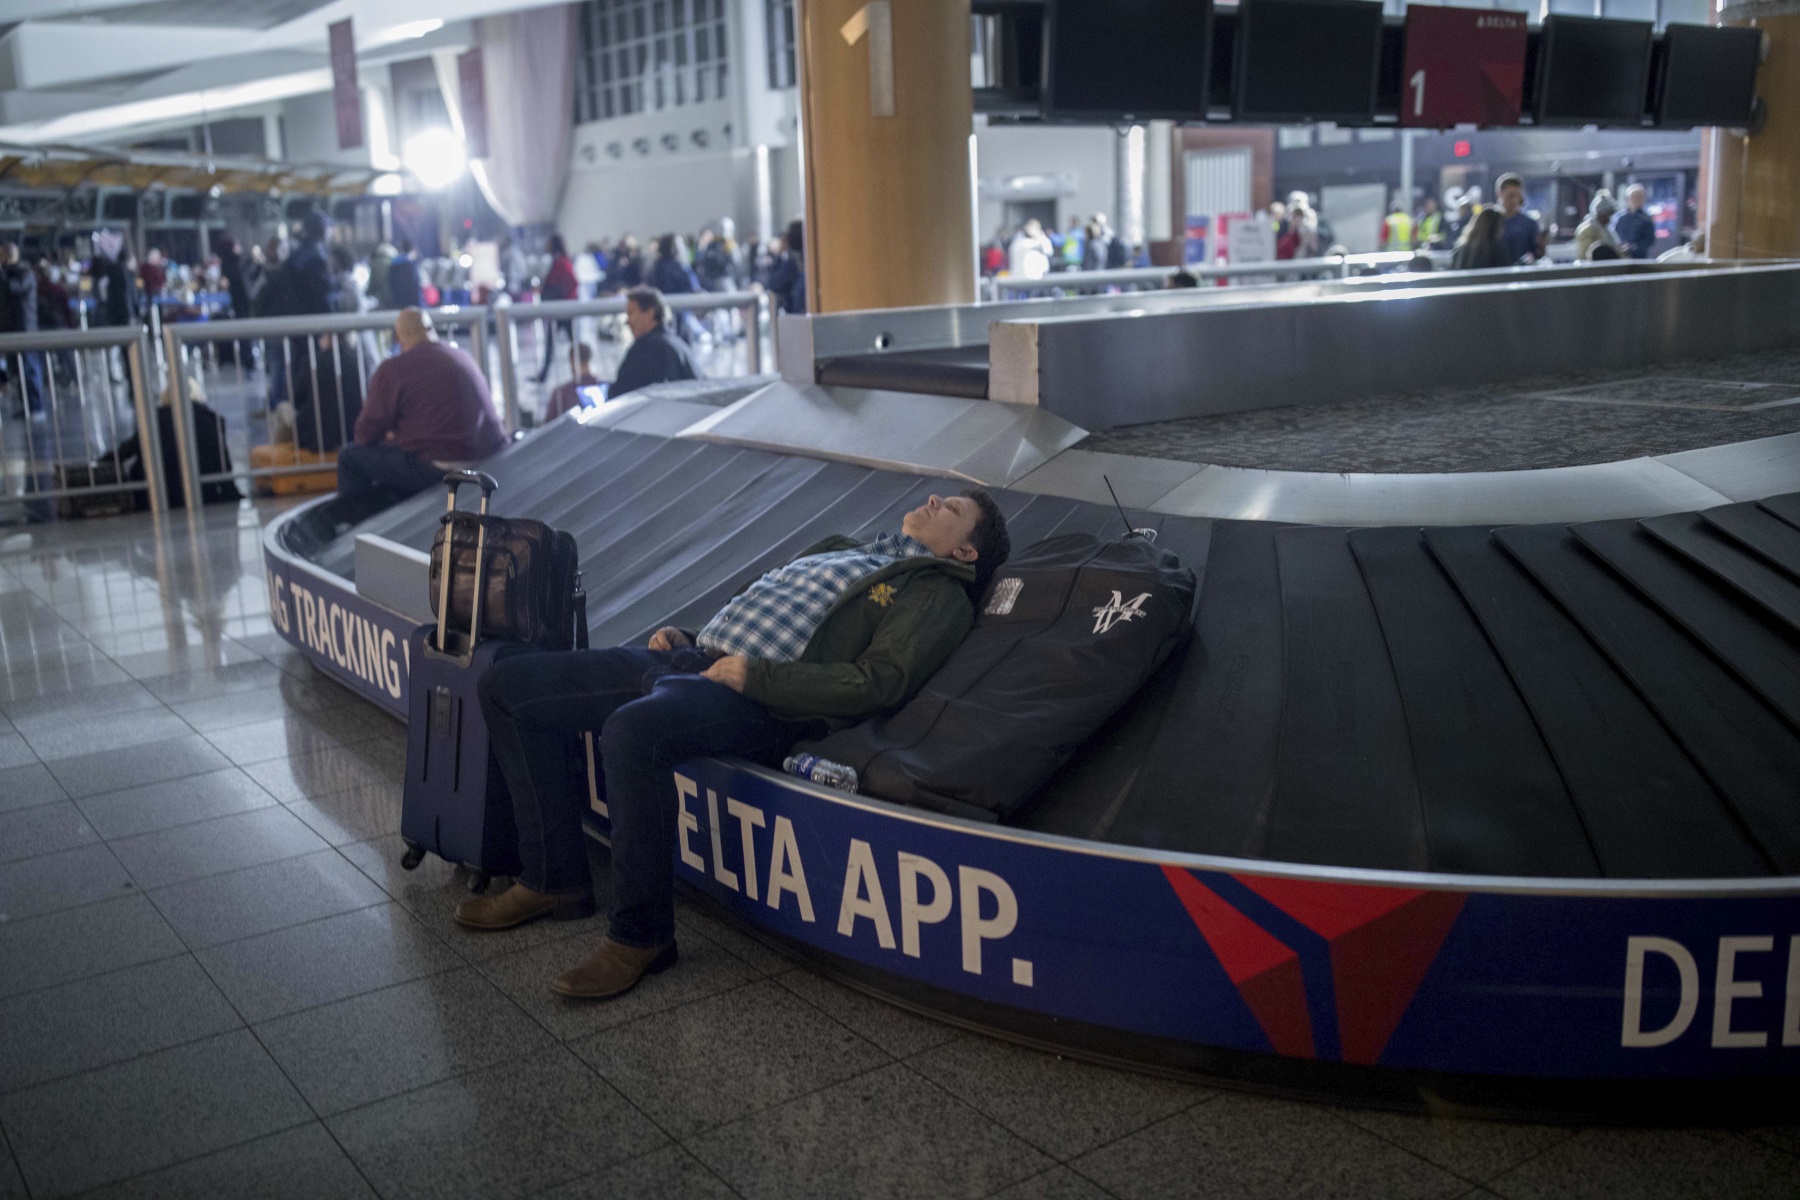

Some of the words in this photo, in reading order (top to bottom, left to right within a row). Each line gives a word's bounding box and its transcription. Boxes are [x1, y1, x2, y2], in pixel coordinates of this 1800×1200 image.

[840, 0, 895, 117] 1
[1409, 69, 1426, 116] 1
[290, 582, 401, 699] TRACKING
[673, 771, 816, 923] ELTA
[837, 838, 1033, 987] APP.
